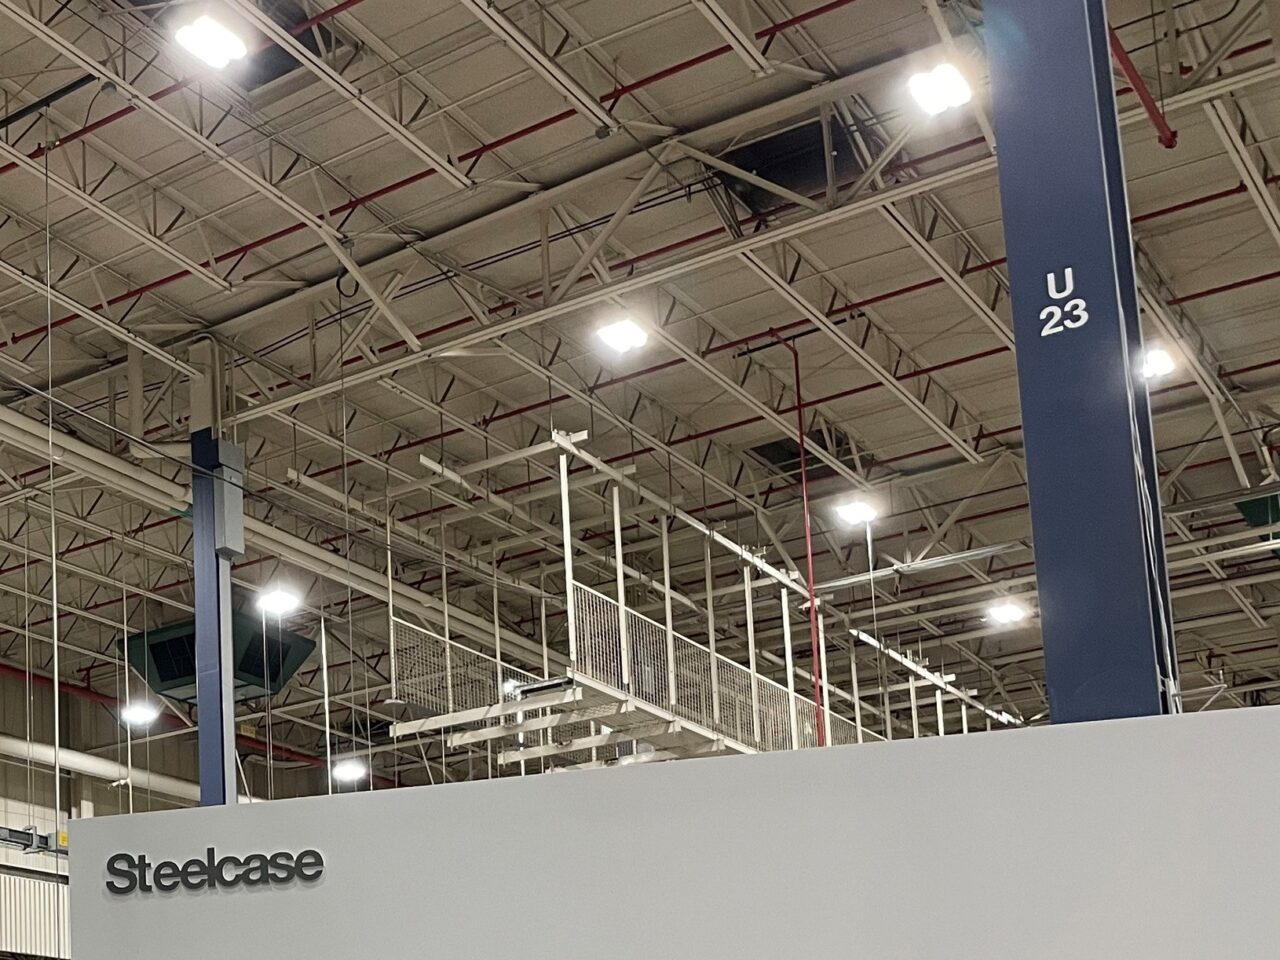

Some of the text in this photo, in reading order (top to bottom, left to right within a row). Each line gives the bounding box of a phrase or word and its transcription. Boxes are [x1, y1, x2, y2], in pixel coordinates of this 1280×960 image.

[1047, 267, 1074, 299] U
[1039, 298, 1089, 337] 23
[106, 847, 324, 894] Steelcase
